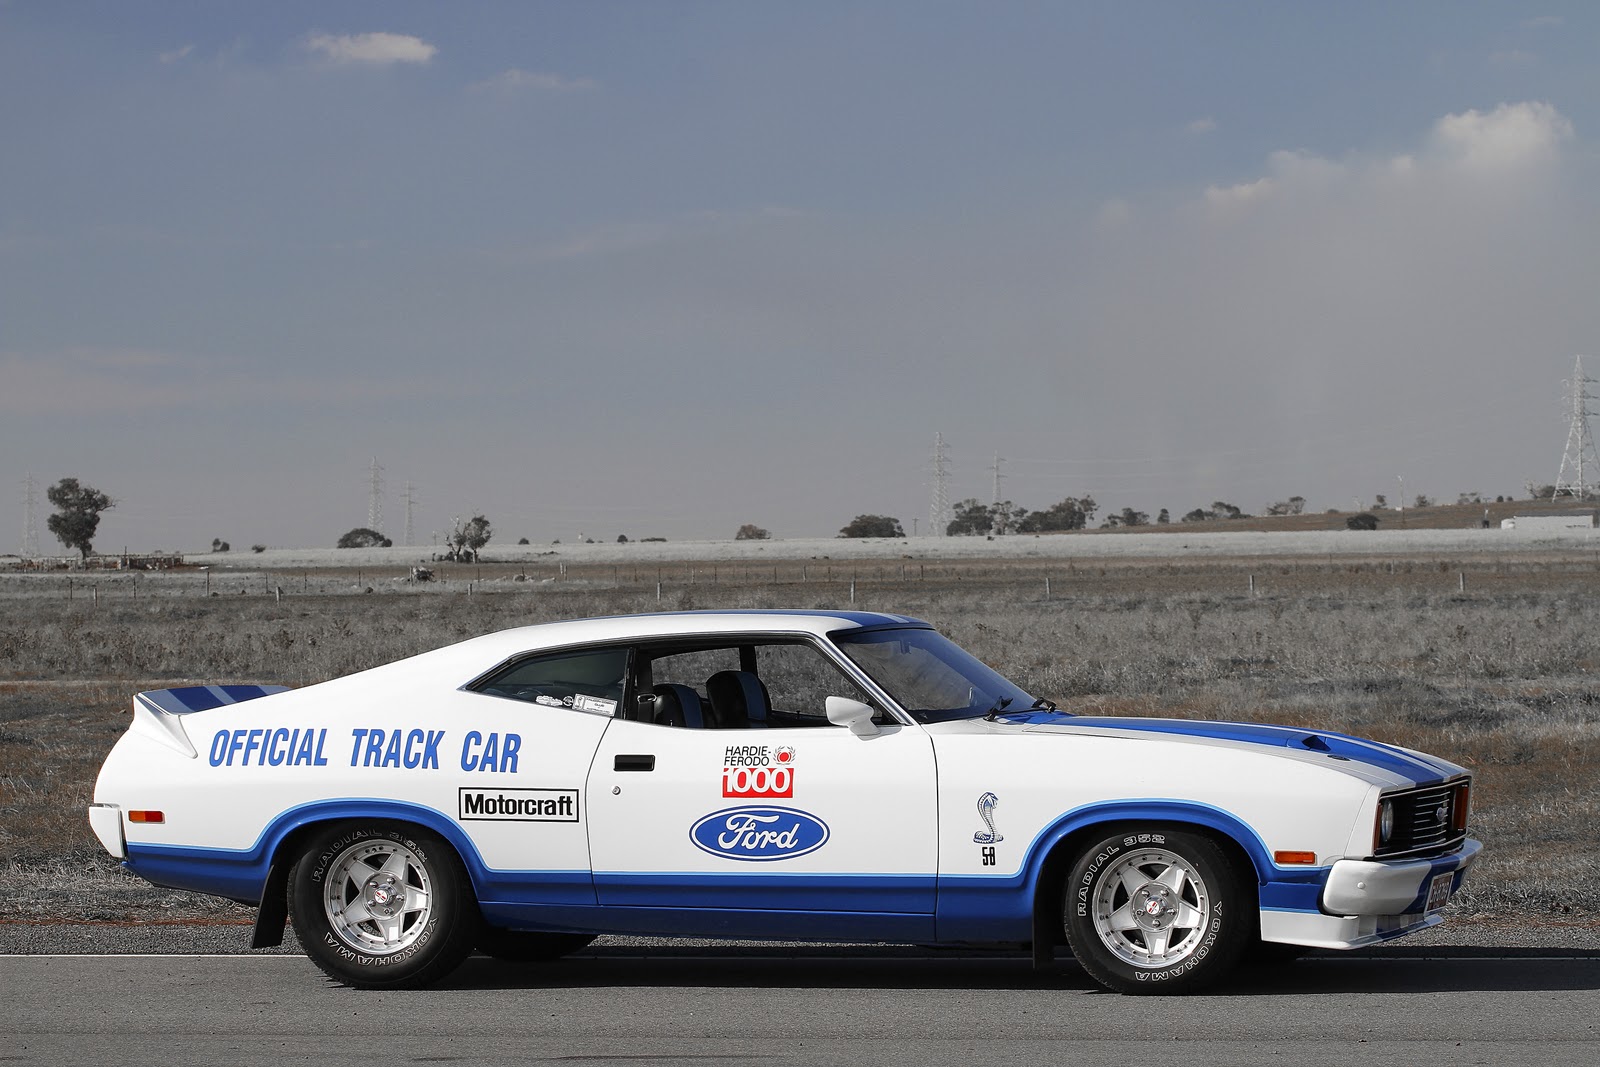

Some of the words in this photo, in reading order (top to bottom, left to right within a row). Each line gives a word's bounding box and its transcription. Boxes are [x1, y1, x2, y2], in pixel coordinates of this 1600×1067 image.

[208, 728, 328, 767] OFFICIAL
[350, 729, 445, 770] TRACK
[460, 730, 522, 774] CAR
[724, 757, 770, 766] FERODO
[725, 746, 771, 756] HARDIE-
[725, 768, 791, 793] 1000
[464, 793, 574, 817] Motorcraft
[717, 813, 801, 850] Ford
[312, 829, 383, 883] RADIAL
[982, 846, 996, 866] 58
[1077, 845, 1120, 917] RADIAL
[324, 917, 439, 967] YOKOHAMA
[1135, 901, 1223, 982] YOKOHAMA
